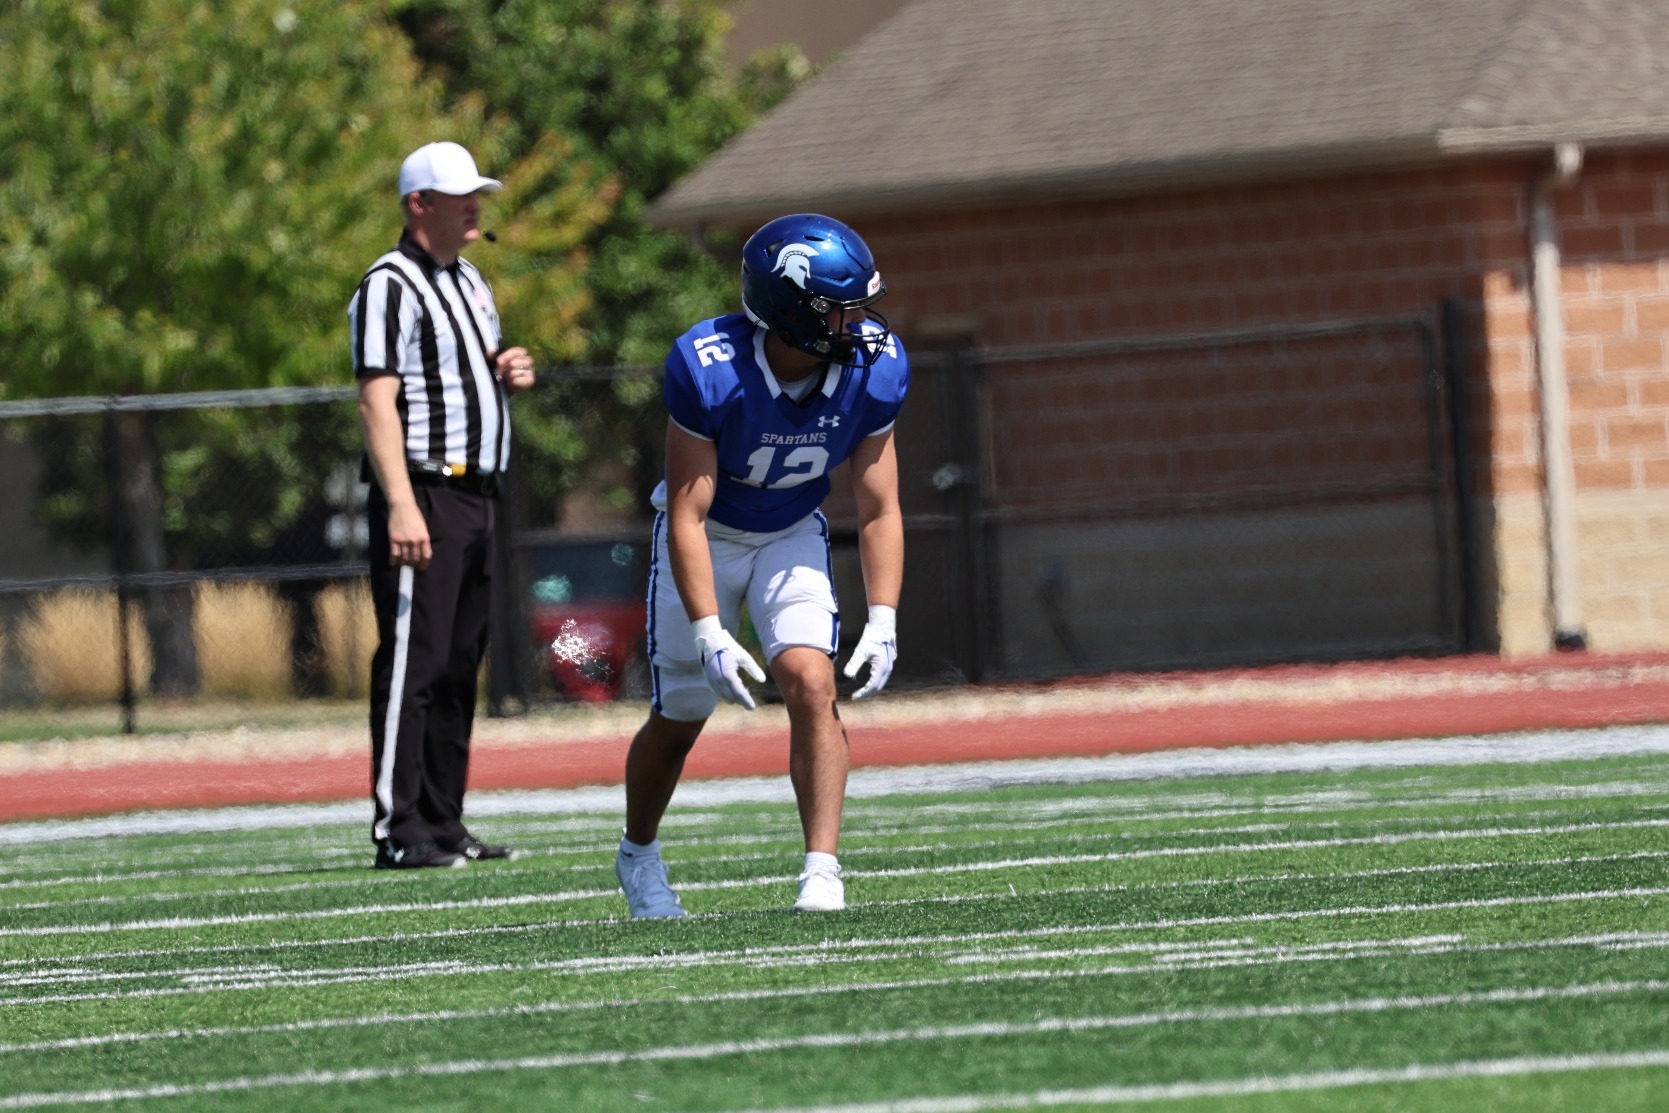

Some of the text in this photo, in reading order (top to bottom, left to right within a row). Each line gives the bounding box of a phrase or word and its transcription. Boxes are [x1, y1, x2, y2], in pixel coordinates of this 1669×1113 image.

[693, 332, 736, 368] 12
[760, 432, 828, 445] SPARTANS
[730, 446, 830, 490] 12
